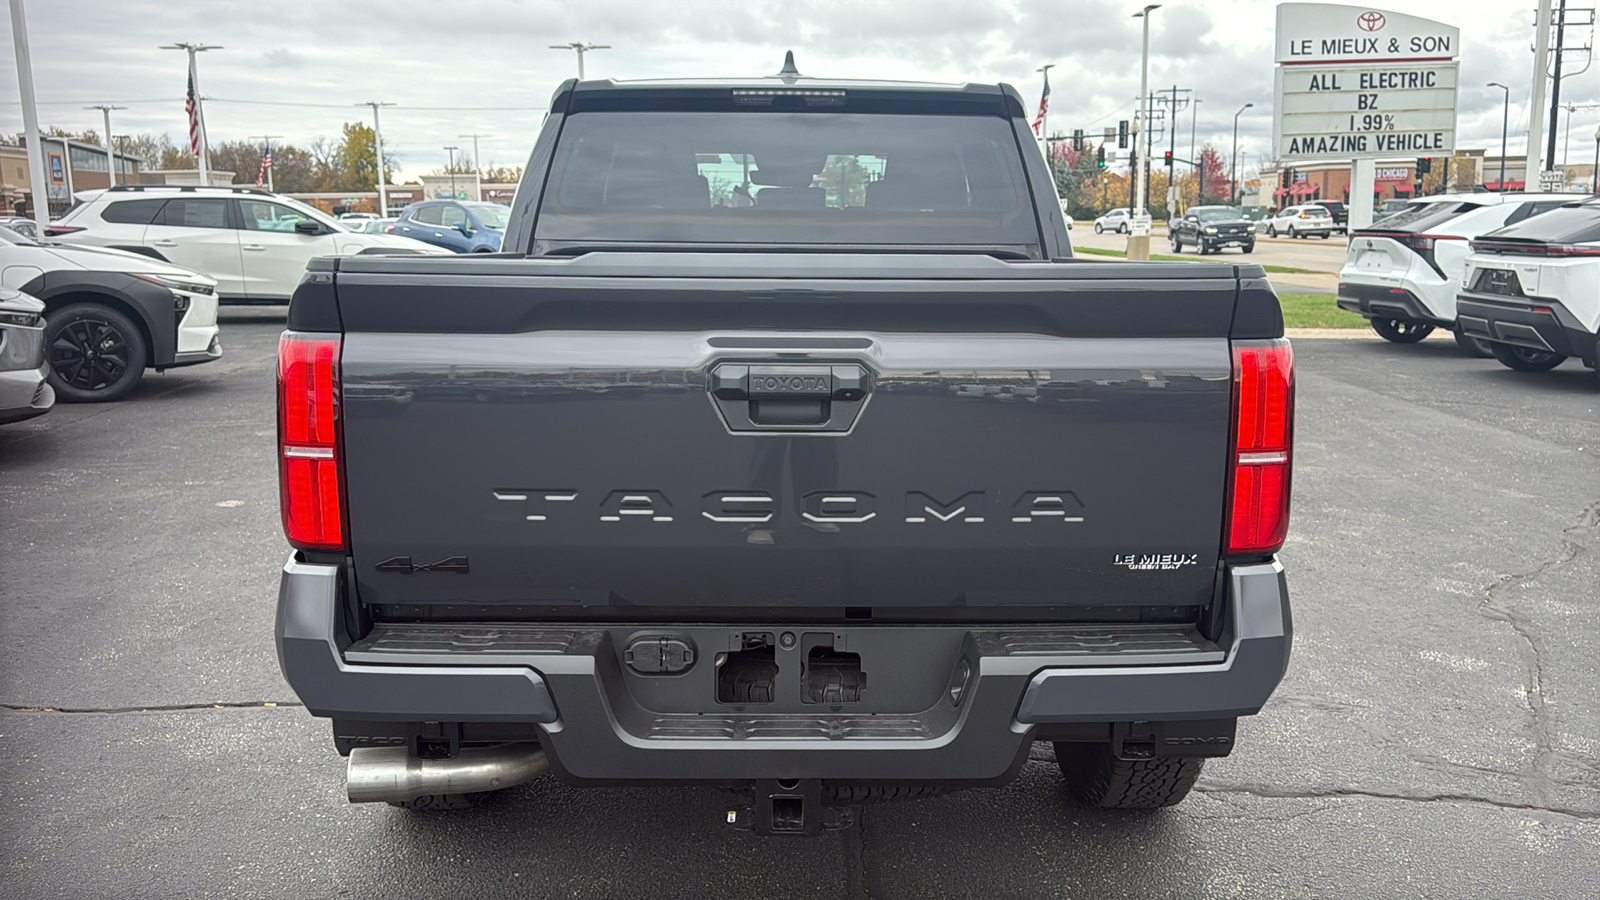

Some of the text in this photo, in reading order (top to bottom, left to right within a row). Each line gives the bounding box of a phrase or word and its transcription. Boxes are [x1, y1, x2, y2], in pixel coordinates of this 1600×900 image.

[1290, 36, 1450, 56] LE MIEUX & SON
[1309, 71, 1436, 91] ALL ELECTRIC
[1358, 94, 1378, 110] BZ
[1350, 114, 1394, 131] 1.99%
[1288, 132, 1443, 154] AMAZING VEHICLE
[753, 376, 828, 391] TOYOTA
[492, 487, 1086, 523] TACOMA
[374, 555, 470, 575] 4x4
[1113, 553, 1198, 565] LE MIEUX
